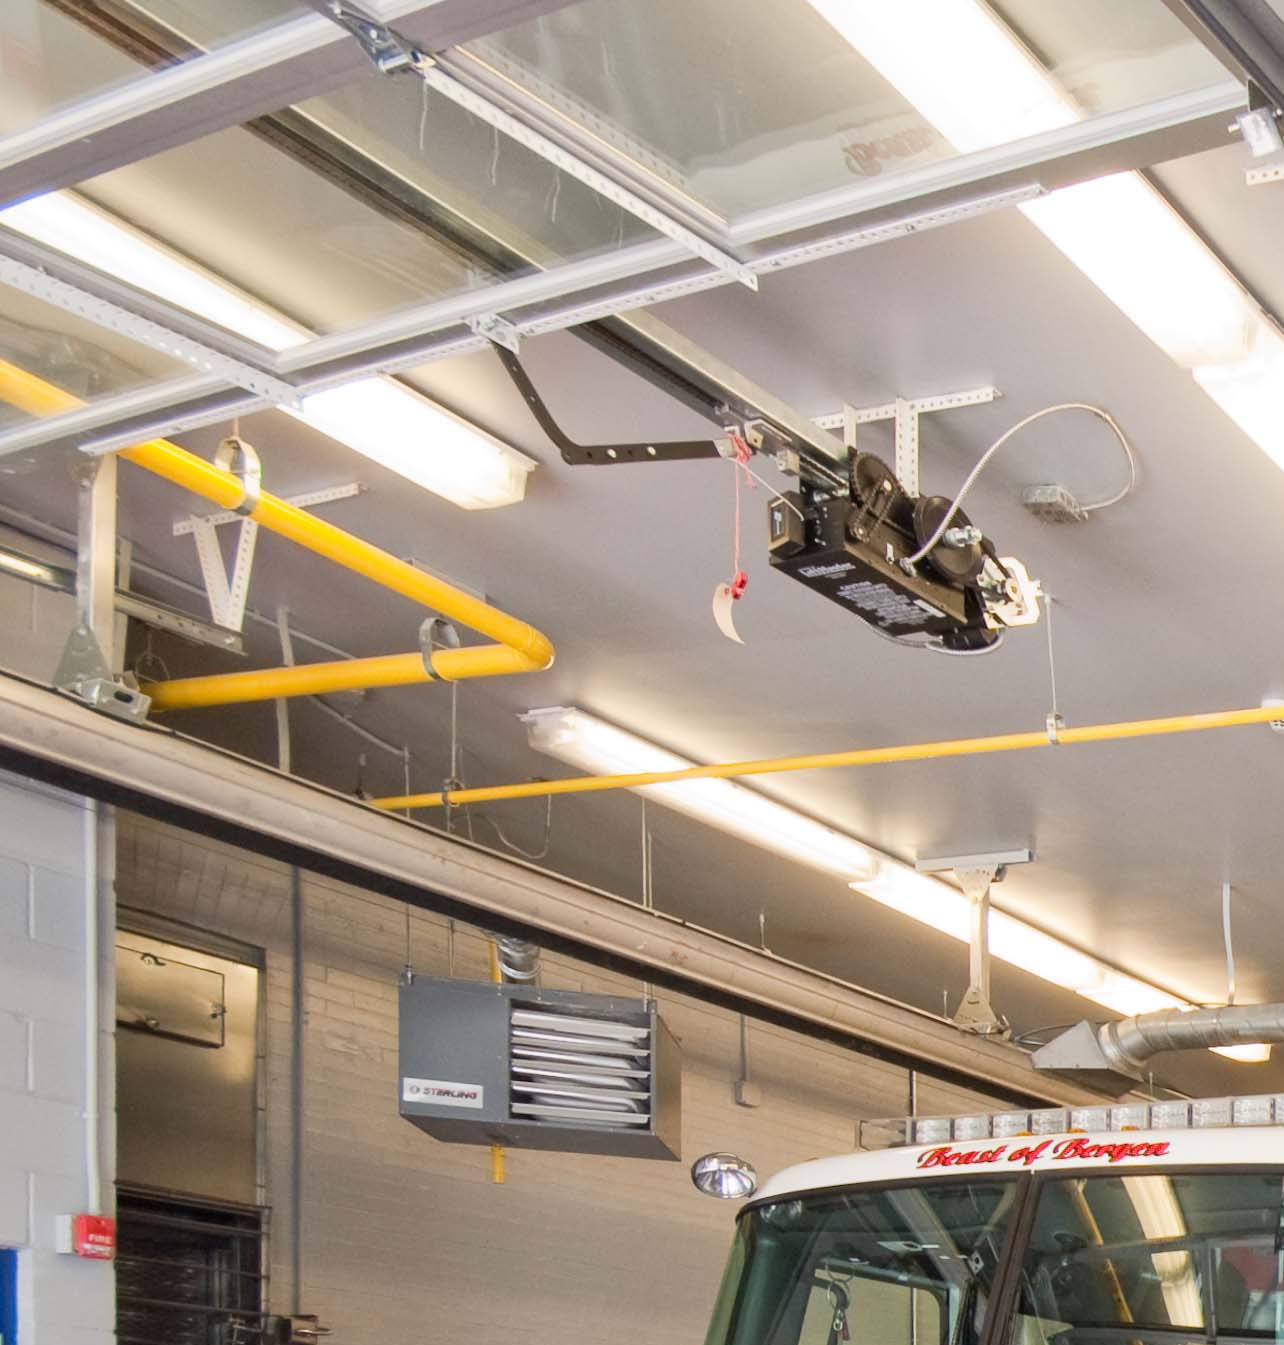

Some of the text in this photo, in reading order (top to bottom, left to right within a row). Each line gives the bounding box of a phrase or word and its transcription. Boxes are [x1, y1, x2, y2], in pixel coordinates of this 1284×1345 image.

[422, 1087, 478, 1100] STERLING
[916, 1138, 1170, 1169] Beast of Bergen
